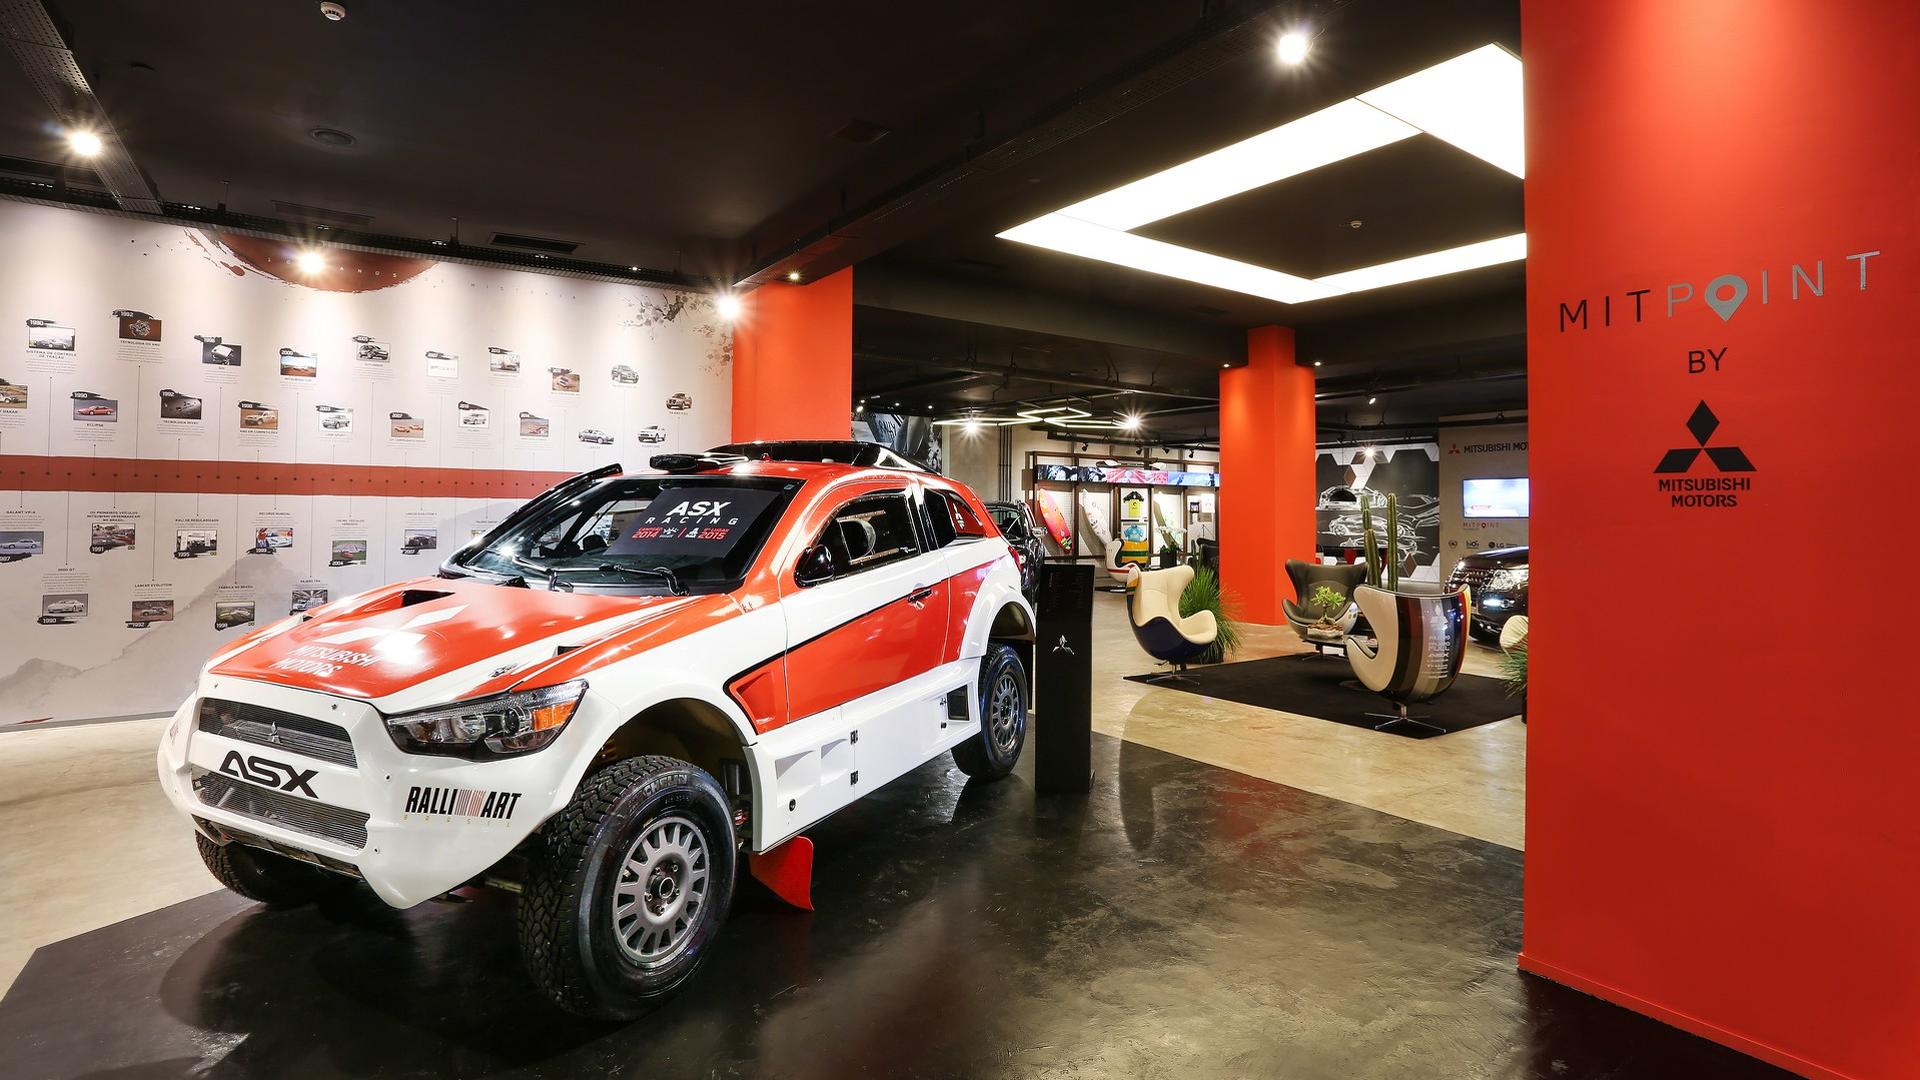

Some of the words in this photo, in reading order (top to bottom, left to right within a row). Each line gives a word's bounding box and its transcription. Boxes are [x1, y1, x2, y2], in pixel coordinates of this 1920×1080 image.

[1687, 346, 1729, 374] BY
[1463, 444, 1511, 454] MITSUBISHI
[1657, 477, 1751, 493] MITSUBISHI
[666, 501, 732, 517] ASX
[1670, 494, 1738, 508] MOTORS
[645, 517, 739, 526] RACING
[632, 531, 659, 539] 2014
[698, 531, 727, 540] 2015
[288, 646, 383, 669] MITSUBISHI
[268, 657, 343, 678] MOTORS
[218, 750, 319, 799] ASX
